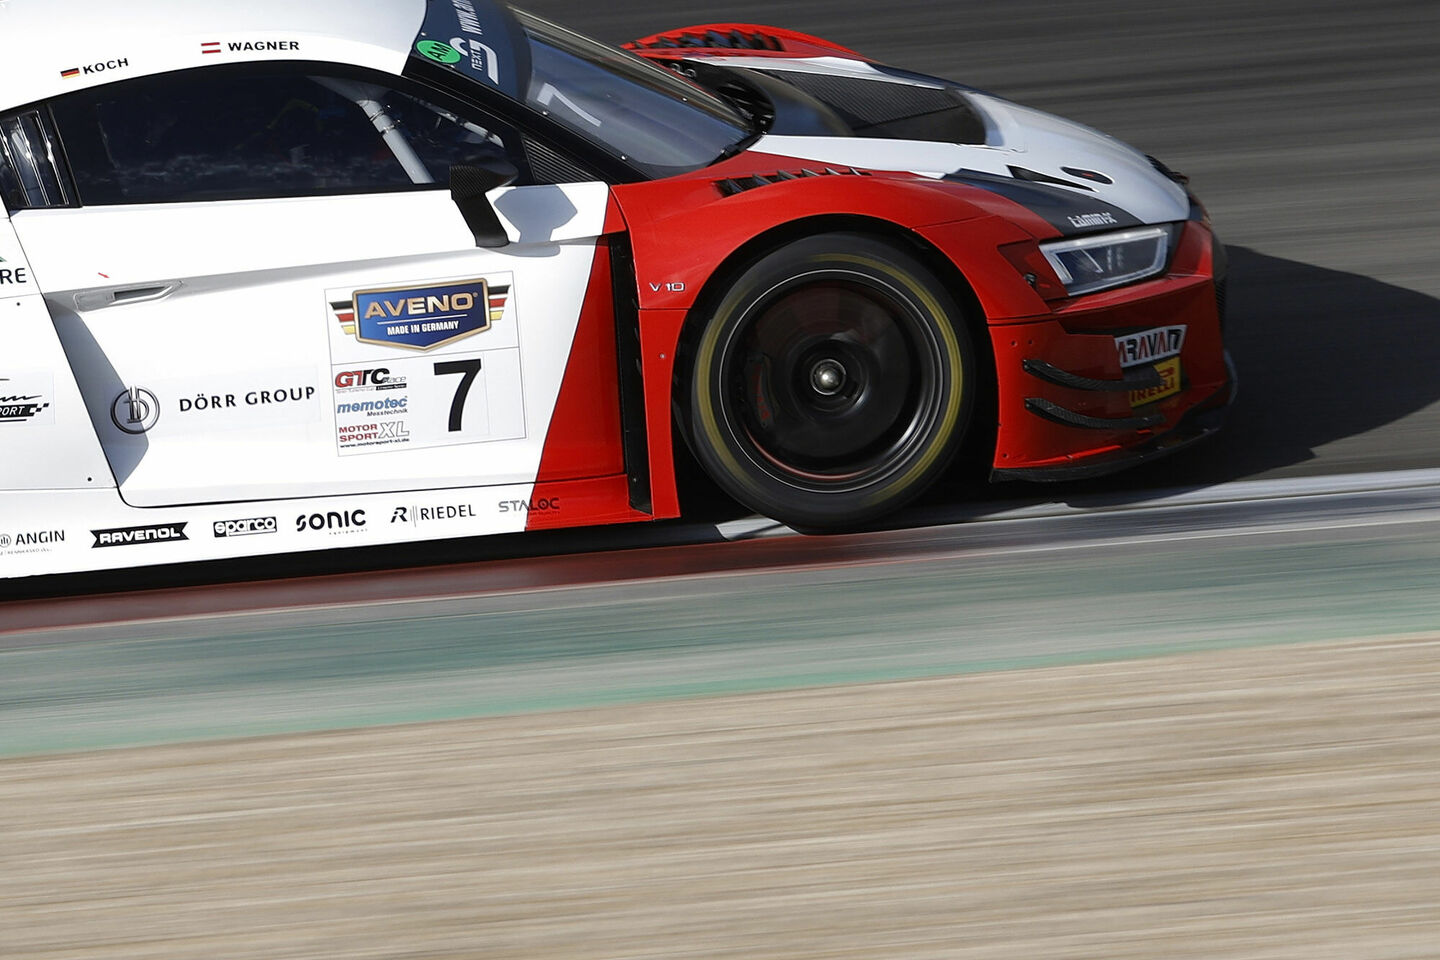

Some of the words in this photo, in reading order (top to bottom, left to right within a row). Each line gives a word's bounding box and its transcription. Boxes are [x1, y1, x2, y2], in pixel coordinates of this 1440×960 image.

[227, 40, 300, 52] WAGNER
[426, 42, 451, 61] AM
[82, 57, 130, 75] KOCH
[364, 292, 474, 320] AVENO
[387, 326, 409, 336] MADE
[410, 325, 420, 334] IN
[421, 320, 460, 333] GERMANY
[1117, 328, 1183, 363] ARAVAN
[334, 367, 391, 388] GTC
[179, 393, 237, 413] DÖRR
[245, 386, 316, 406] GROUP
[433, 358, 482, 432] 7
[336, 396, 408, 414] memotec
[366, 408, 409, 417] Messtechnik
[338, 423, 378, 433] MOTOR
[339, 432, 379, 443] SPORT
[377, 420, 410, 440] XL
[420, 504, 477, 521] RIEDEL
[498, 497, 560, 513] STALOC
[99, 526, 181, 545] RAVENOL
[214, 517, 276, 537] sparco
[15, 529, 65, 545] ANGIN
